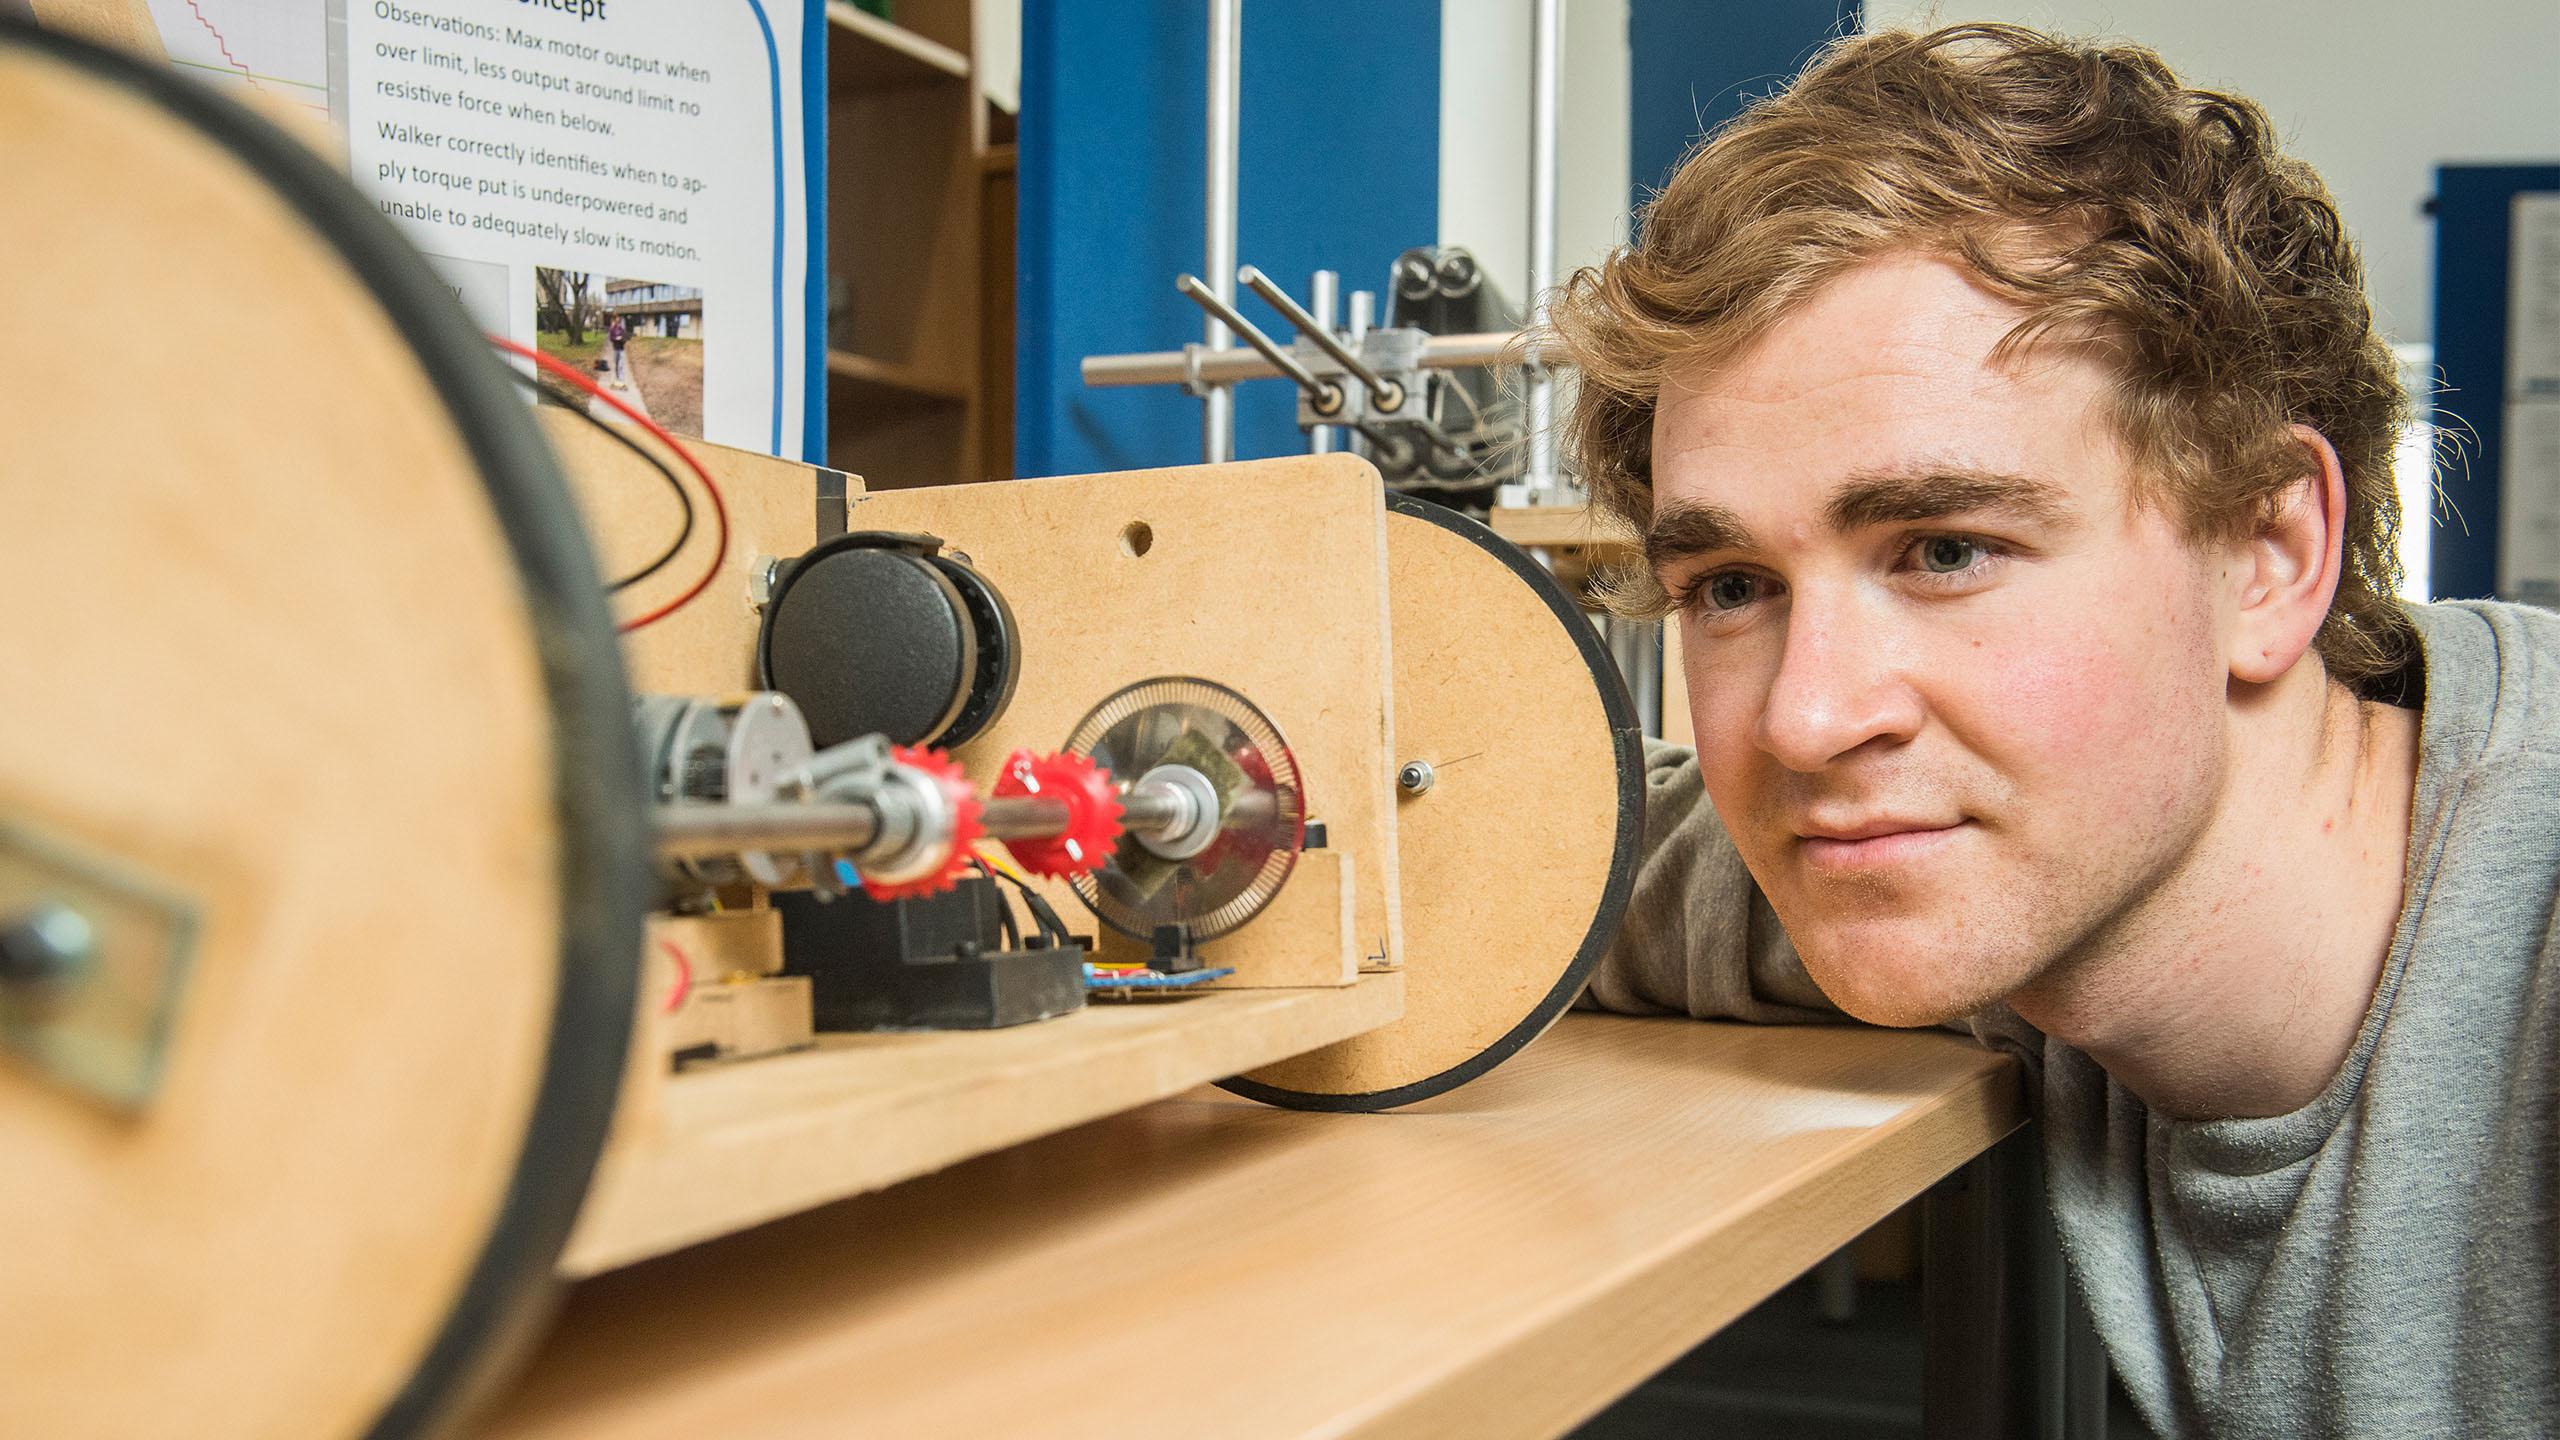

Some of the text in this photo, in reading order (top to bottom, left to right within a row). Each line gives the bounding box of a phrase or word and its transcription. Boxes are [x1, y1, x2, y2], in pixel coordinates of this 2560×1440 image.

[375, 1, 710, 82] Observations: Max motor output when
[376, 42, 700, 116] over limit, less output around limit no
[377, 80, 615, 136] resistive force when below.
[377, 121, 708, 195] Walker correctly identifies when to ap-
[378, 160, 688, 224] ply torque put is underpowered and
[380, 200, 701, 261] unable to adequately slow its motion.
